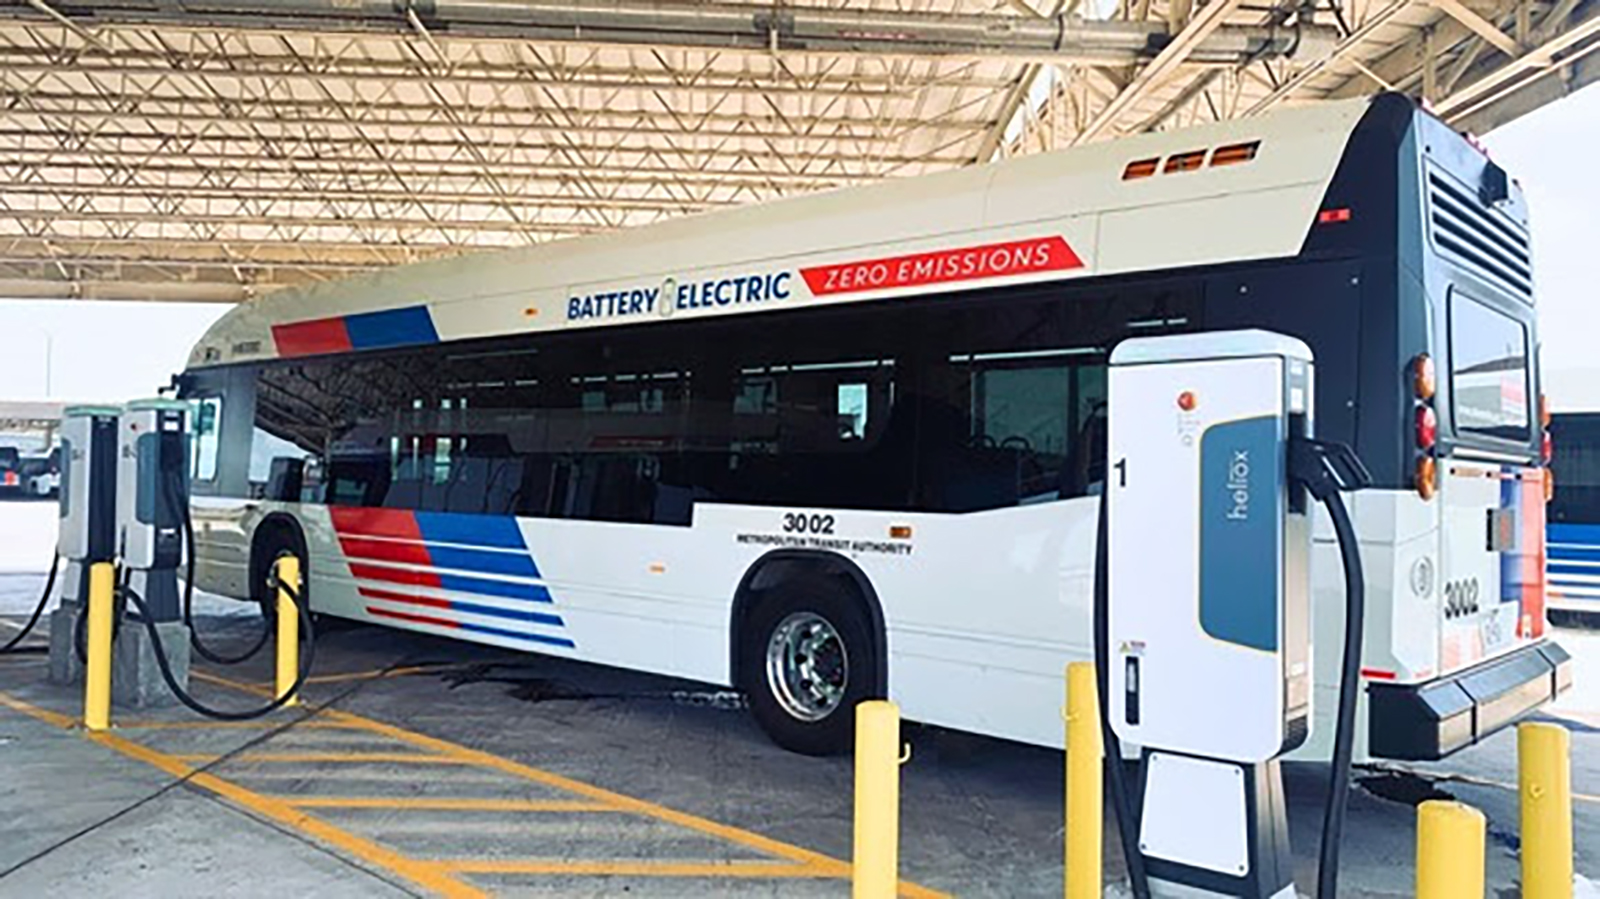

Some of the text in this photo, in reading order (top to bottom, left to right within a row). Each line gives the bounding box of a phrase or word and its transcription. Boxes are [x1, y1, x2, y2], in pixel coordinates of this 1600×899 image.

[567, 243, 1052, 320] BATTERY ELECTRIC ZERO EMISSIONS
[1113, 458, 1126, 487] 1
[1226, 450, 1249, 519] heliox
[783, 512, 835, 534] 3002
[737, 533, 912, 555] METROPOLITAN TRANSIT AUTHORITY
[1444, 576, 1479, 620] 3002
